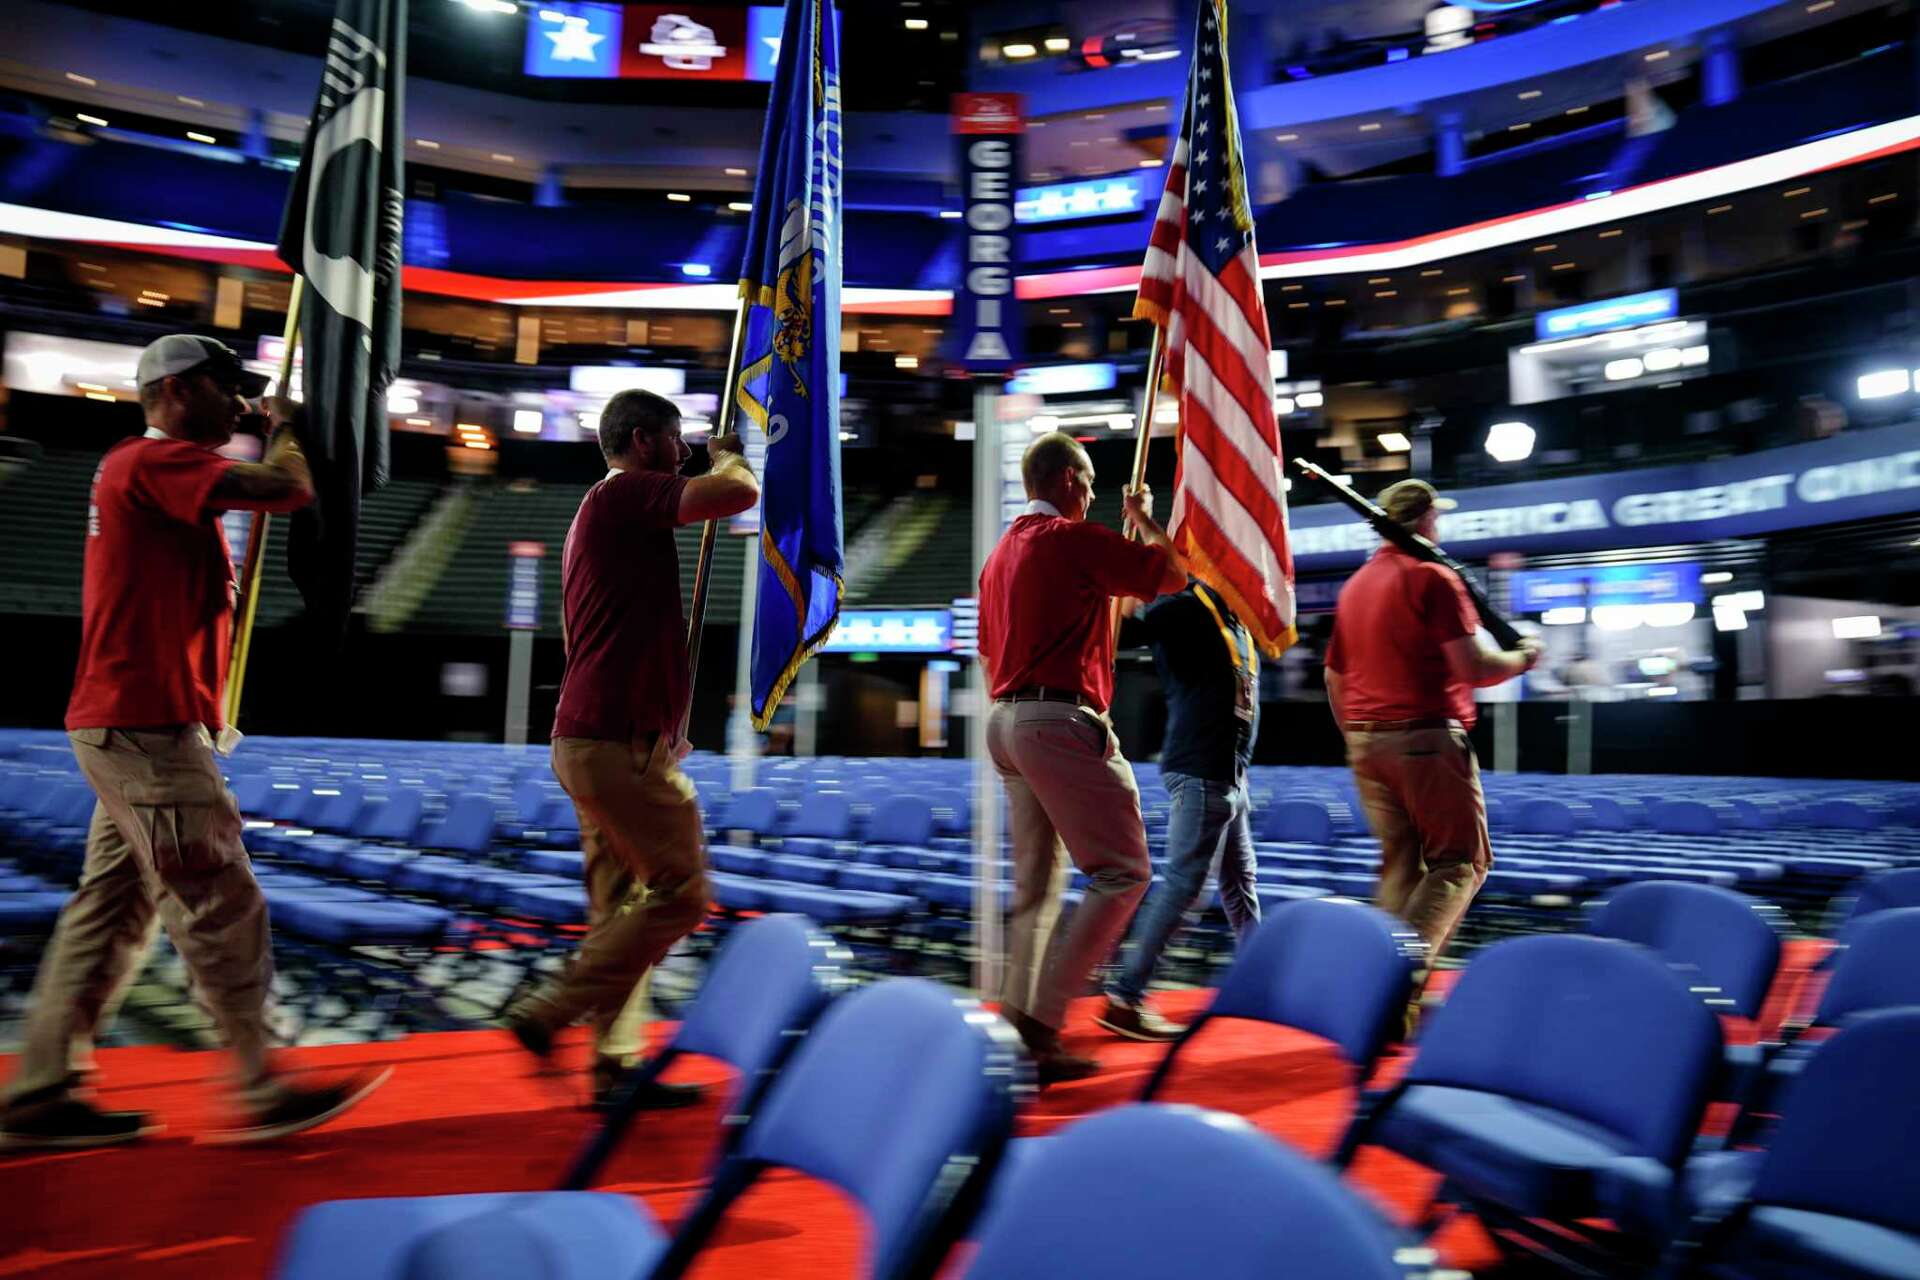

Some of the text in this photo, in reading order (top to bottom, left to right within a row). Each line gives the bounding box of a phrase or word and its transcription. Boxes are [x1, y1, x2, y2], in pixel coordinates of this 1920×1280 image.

[965, 140, 1012, 360] GEORGIA
[1435, 498, 1610, 543] MERICA
[1612, 474, 1796, 528] GREAT
